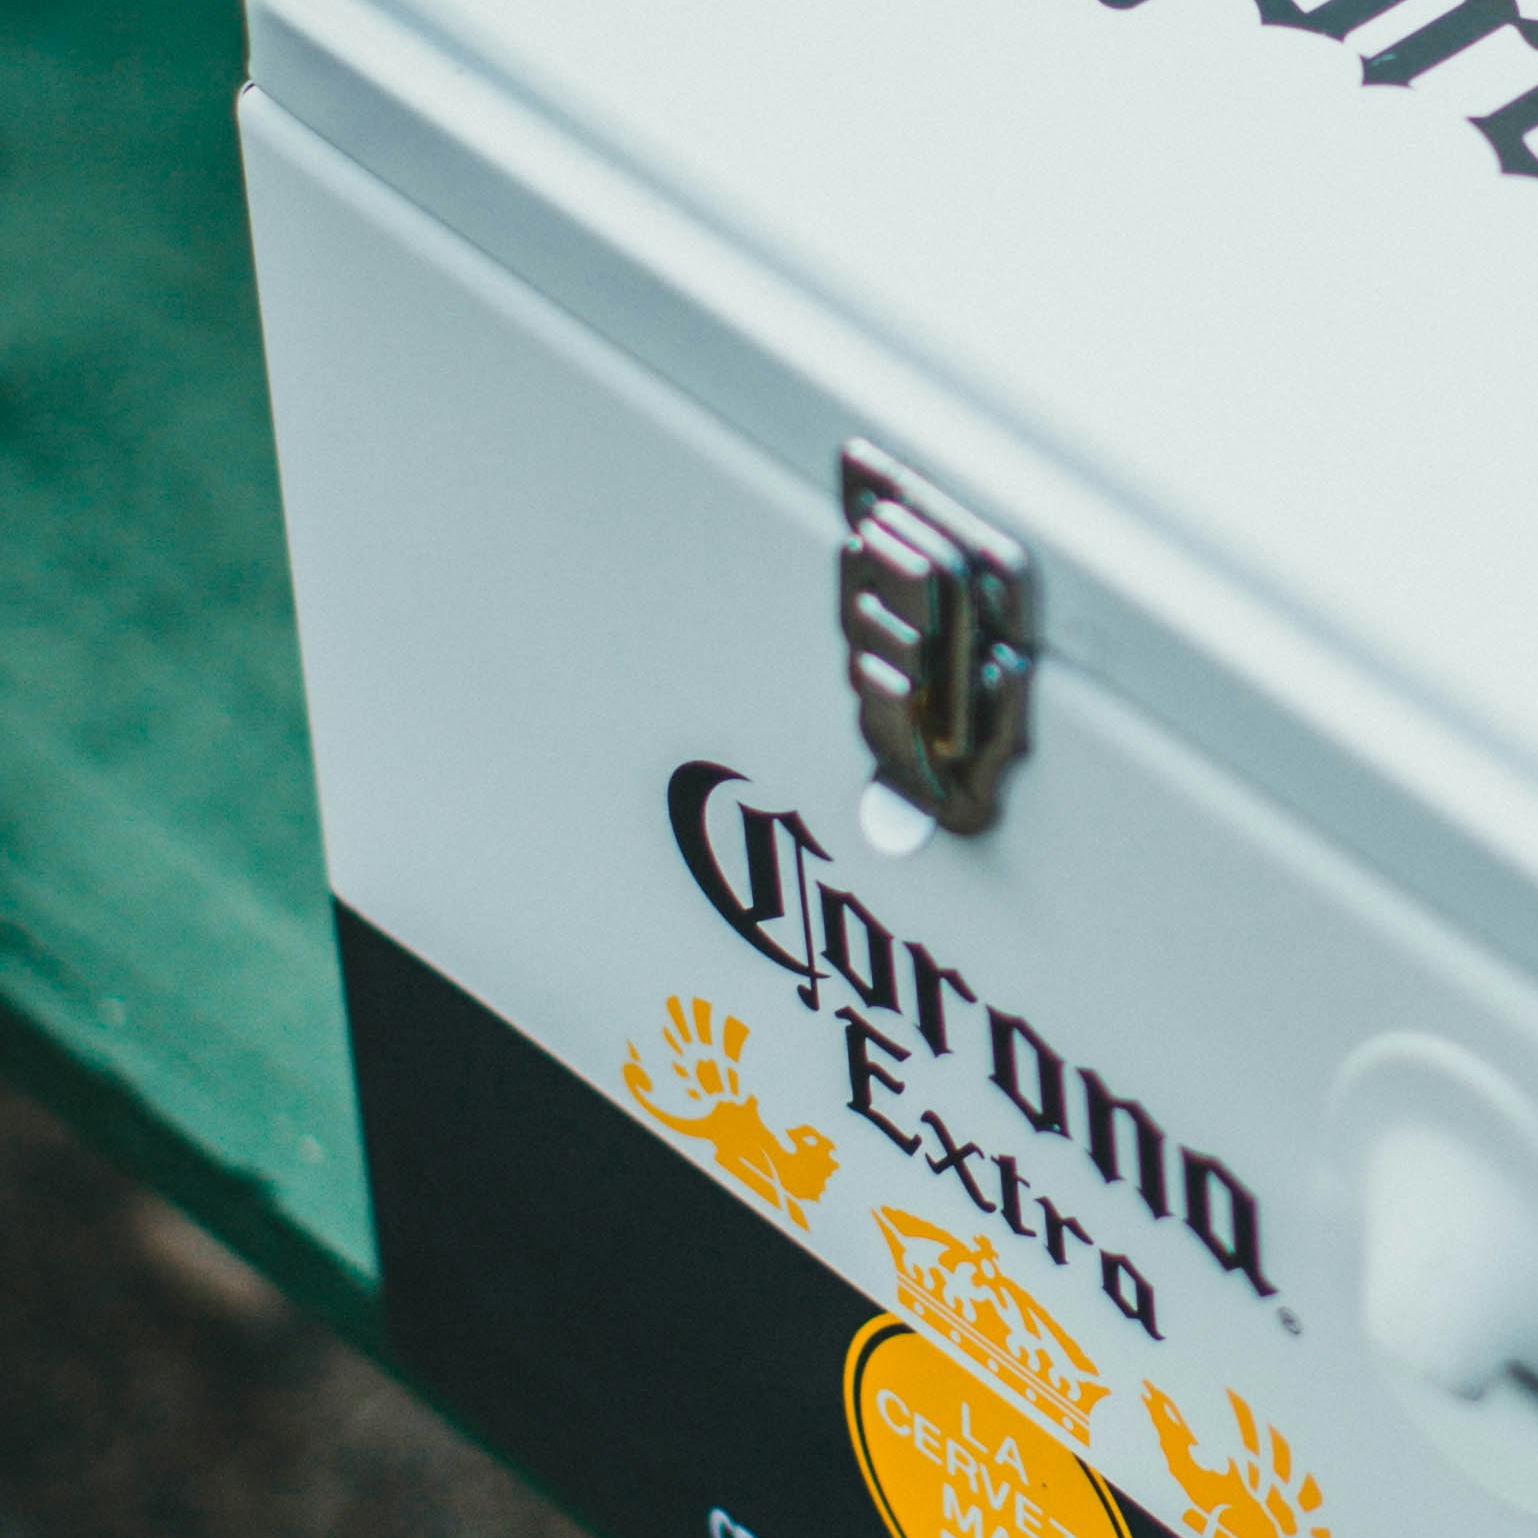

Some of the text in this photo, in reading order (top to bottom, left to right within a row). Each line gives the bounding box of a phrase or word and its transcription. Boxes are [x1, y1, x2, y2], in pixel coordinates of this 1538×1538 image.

[667, 760, 1279, 1298] Corona
[836, 1006, 1166, 1341] Extra
[960, 1399, 1030, 1487] LA
